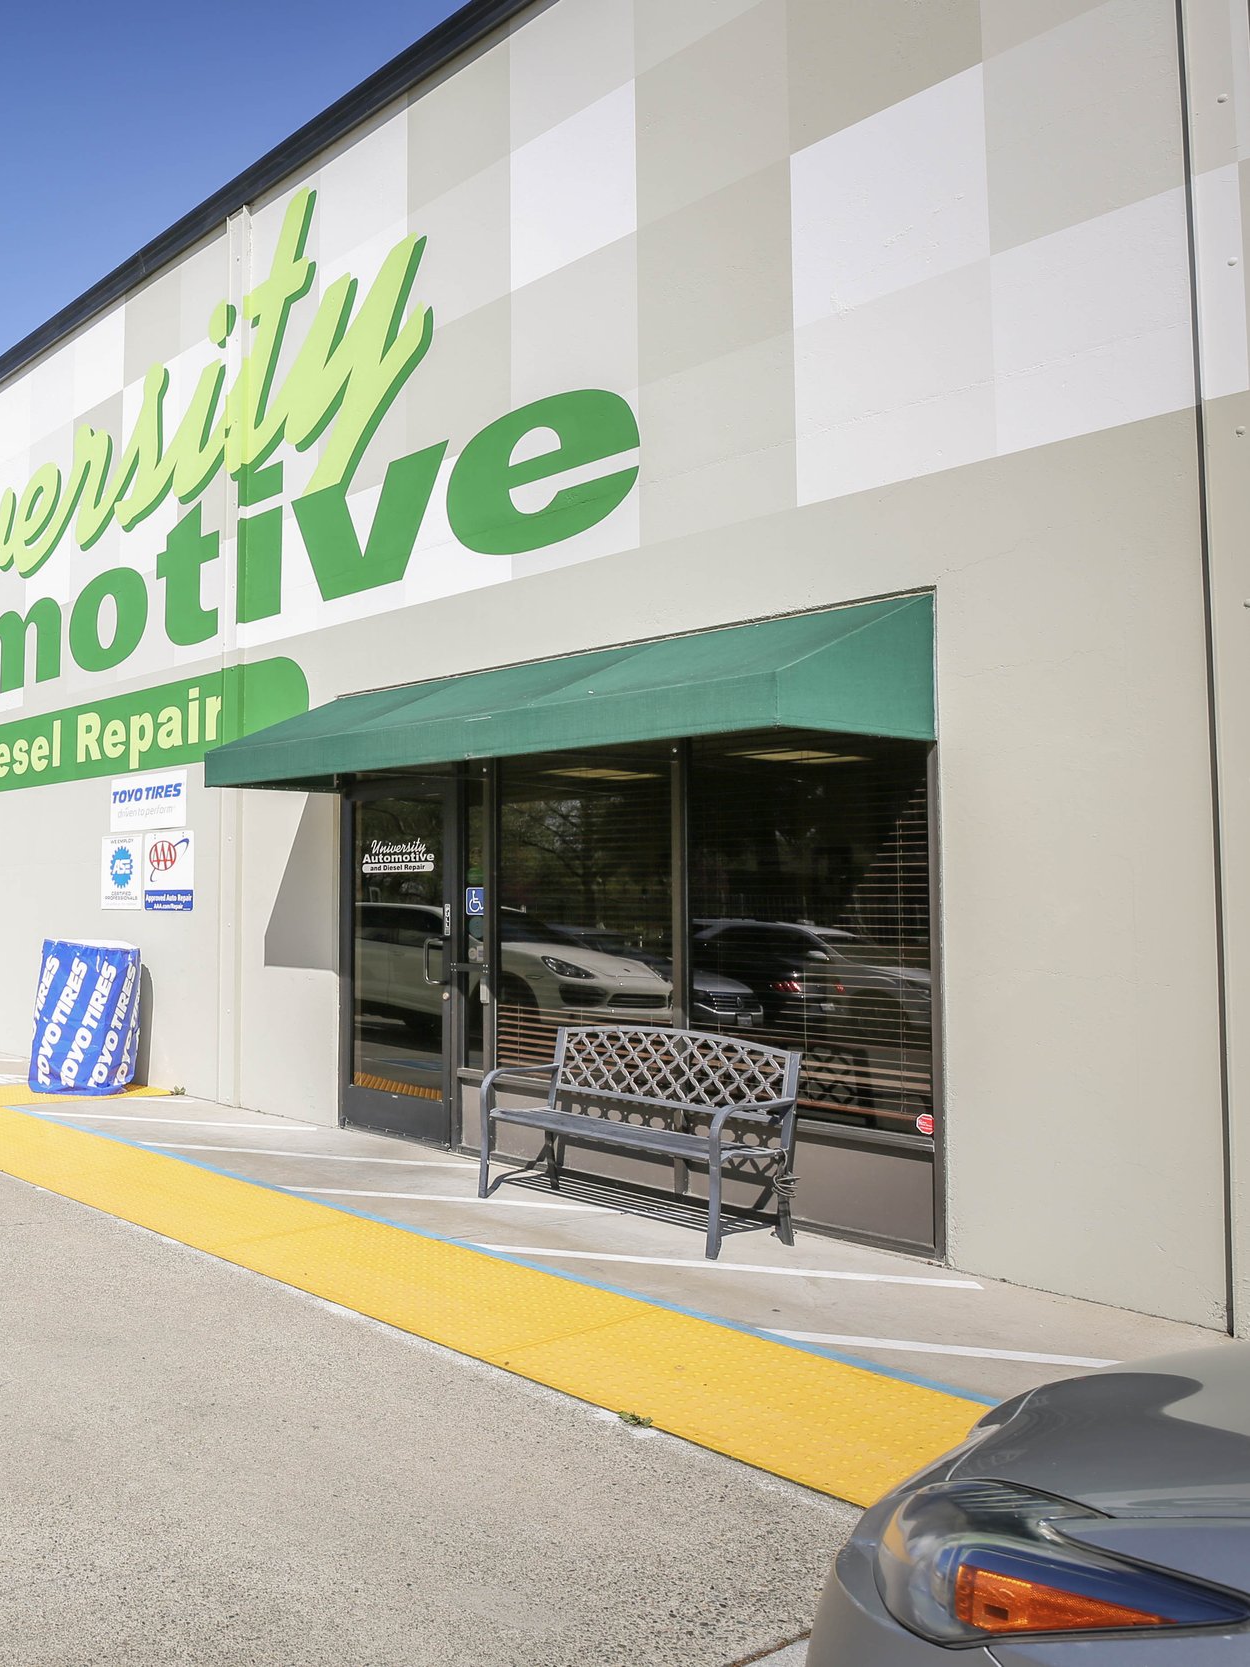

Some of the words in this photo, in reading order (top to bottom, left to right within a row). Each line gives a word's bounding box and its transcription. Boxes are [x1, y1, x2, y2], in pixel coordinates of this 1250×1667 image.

[76, 687, 222, 770] Repair
[112, 787, 143, 804] TOYO
[145, 782, 183, 801] TIRES
[150, 841, 175, 871] AAA
[371, 837, 426, 854] University
[112, 859, 131, 875] ASE
[362, 851, 435, 863] Automotive
[404, 863, 426, 872] Repair
[145, 894, 167, 903] Approved
[177, 894, 192, 903] Repair
[37, 1022, 62, 1086] TOYO
[51, 957, 88, 1025] TIRES
[60, 1027, 93, 1088] TOYO
[81, 960, 117, 1030] TIRES
[87, 1030, 119, 1088] TOYO
[110, 961, 137, 1031] TIRES
